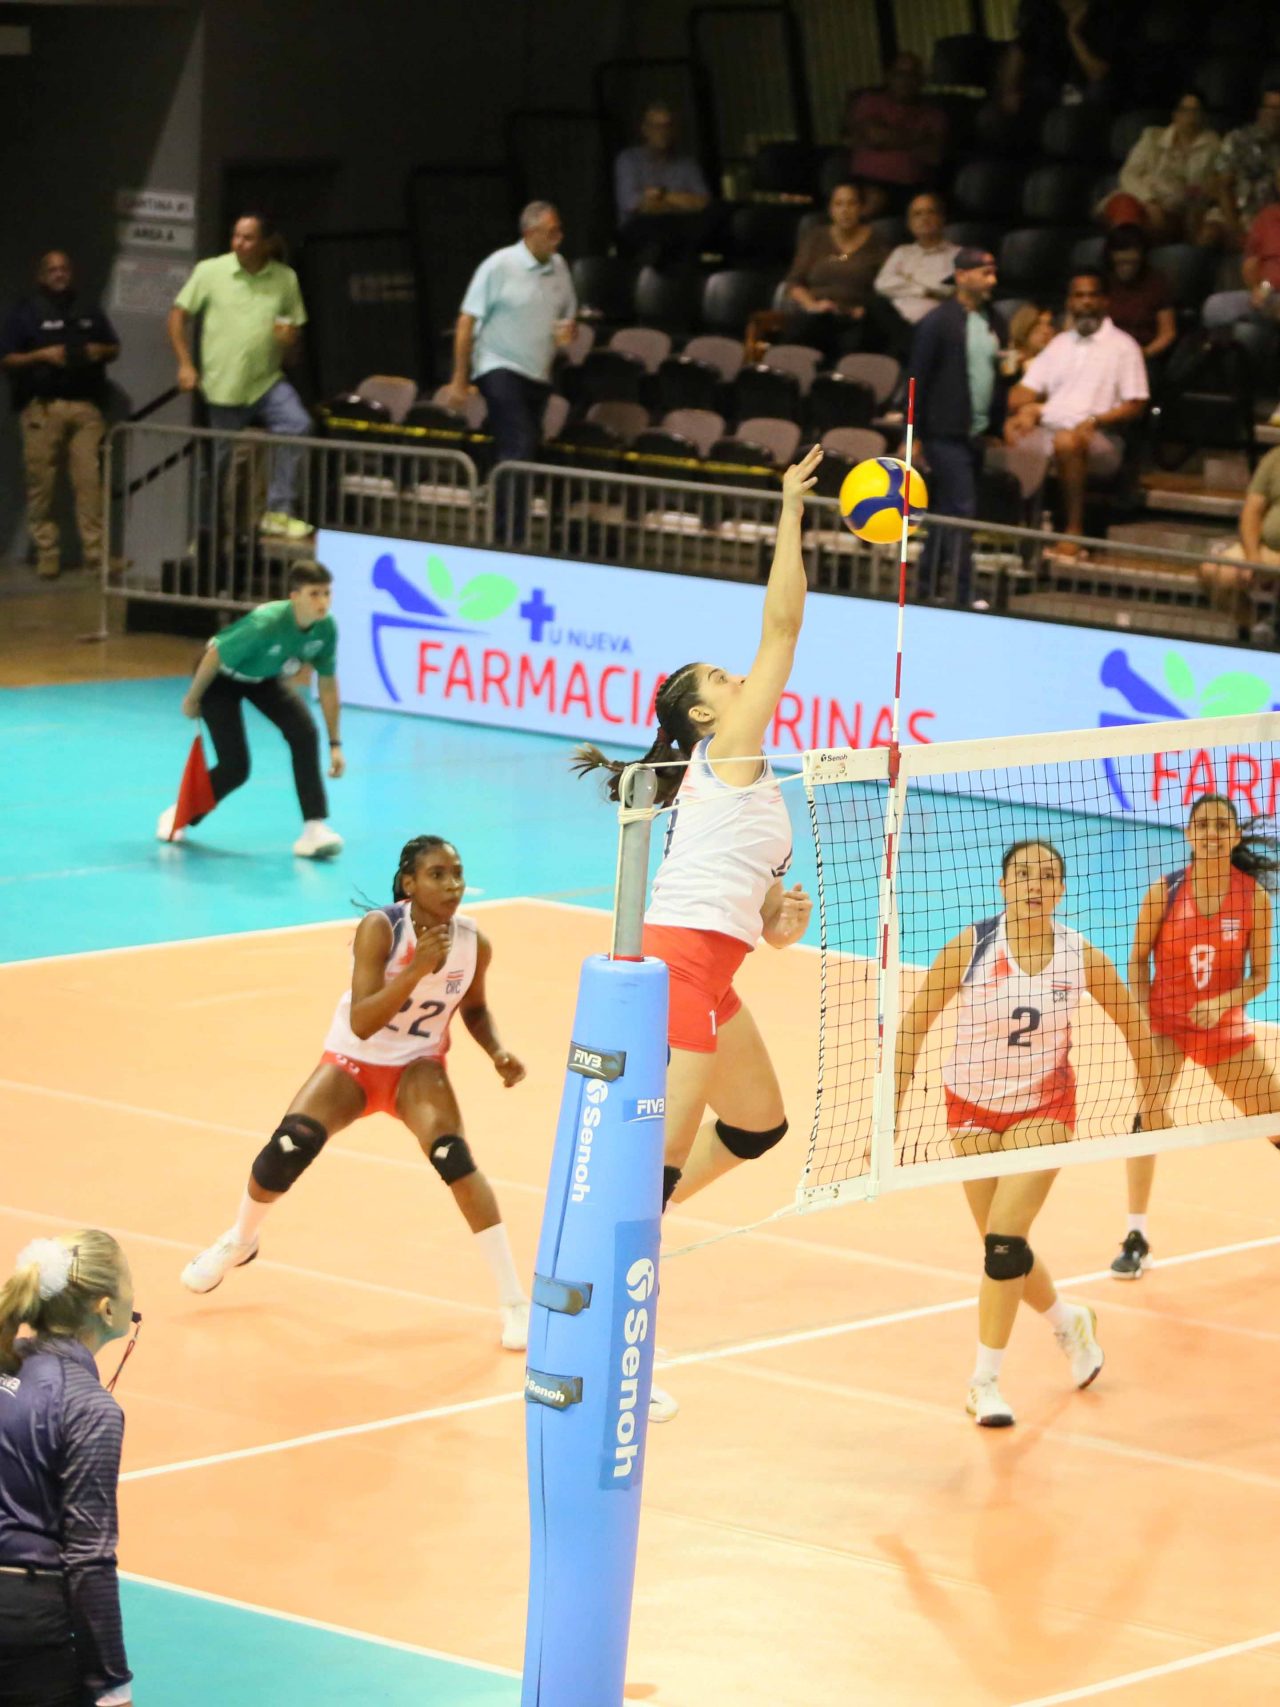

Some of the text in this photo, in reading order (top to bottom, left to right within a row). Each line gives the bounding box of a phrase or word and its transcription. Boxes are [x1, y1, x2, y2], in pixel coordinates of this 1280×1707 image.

[567, 631, 633, 654] NUEVA
[771, 691, 936, 750] RINAS
[1189, 943, 1217, 990] 8
[1007, 1006, 1041, 1048] 2
[574, 1049, 603, 1069] FIVB
[571, 1105, 602, 1203] Senoh
[528, 1378, 566, 1403] Senoh
[613, 1307, 649, 1478] Senoh
